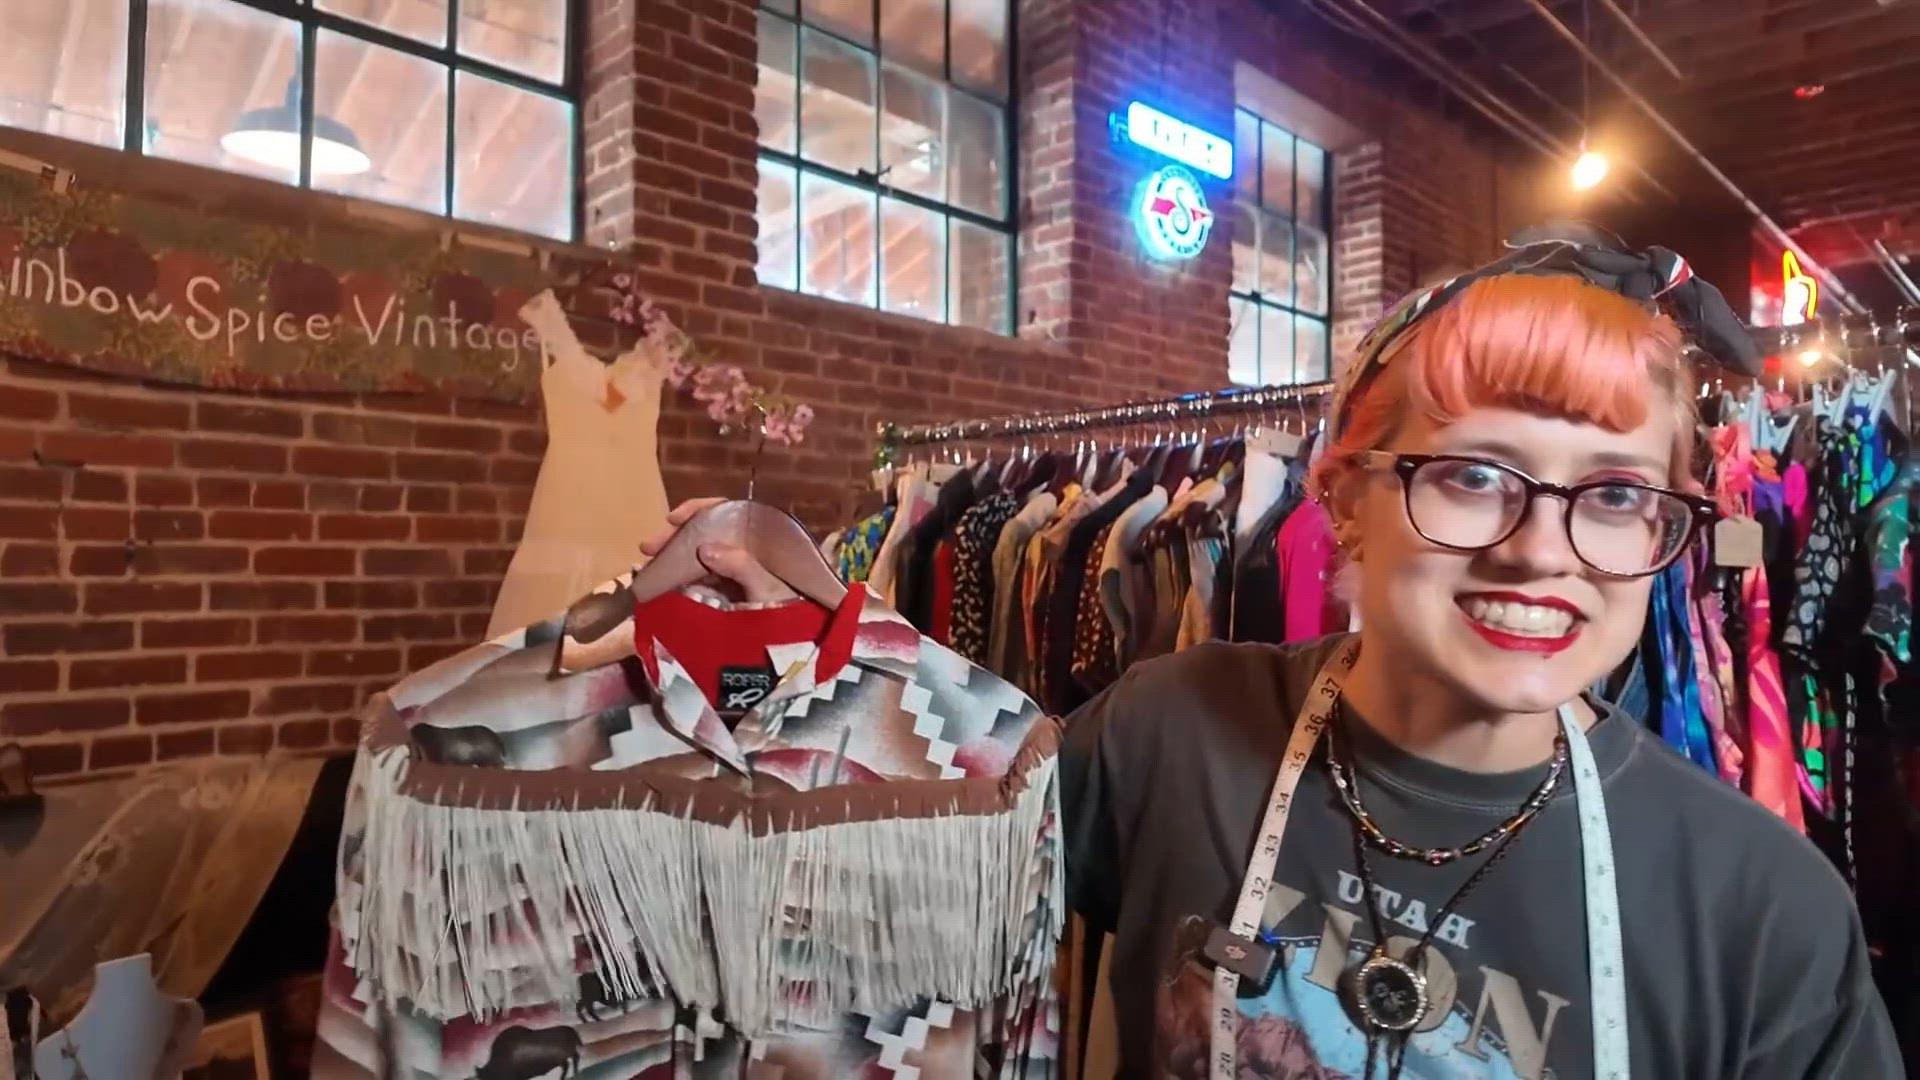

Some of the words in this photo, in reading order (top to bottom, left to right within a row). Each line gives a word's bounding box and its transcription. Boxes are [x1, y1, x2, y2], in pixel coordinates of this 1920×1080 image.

[0, 245, 172, 324] inbow
[185, 275, 332, 356] Spice
[353, 293, 541, 371] Vintage
[1320, 677, 1341, 699] 37
[1304, 713, 1323, 736] 36
[1289, 751, 1306, 772] 35
[1275, 792, 1290, 814] 34
[1264, 834, 1280, 858] 33
[1250, 876, 1268, 901] 32
[1337, 869, 1477, 949] UTAH
